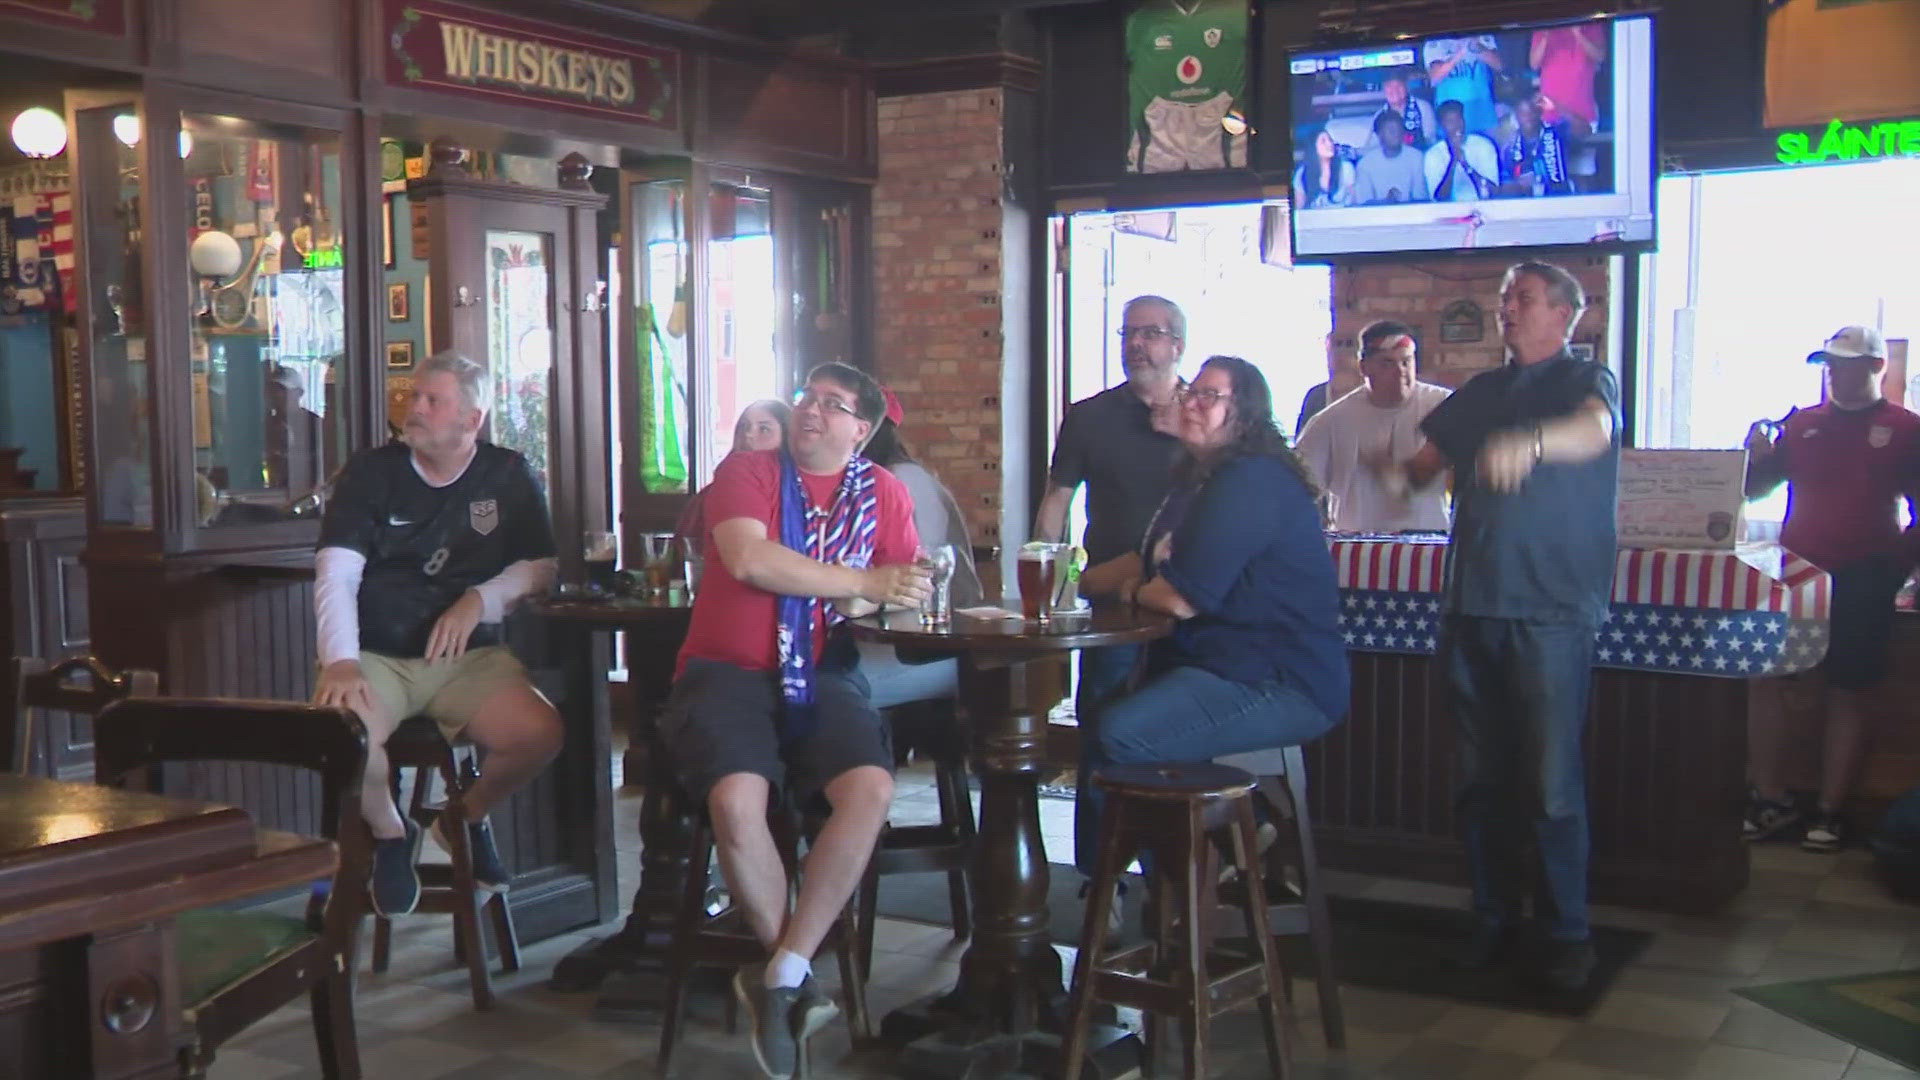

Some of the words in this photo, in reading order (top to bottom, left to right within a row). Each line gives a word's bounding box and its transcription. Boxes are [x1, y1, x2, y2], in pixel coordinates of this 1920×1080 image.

[439, 21, 633, 101] WHISKEYS
[1776, 118, 1920, 165] SLÁINTE
[423, 547, 450, 576] 8
